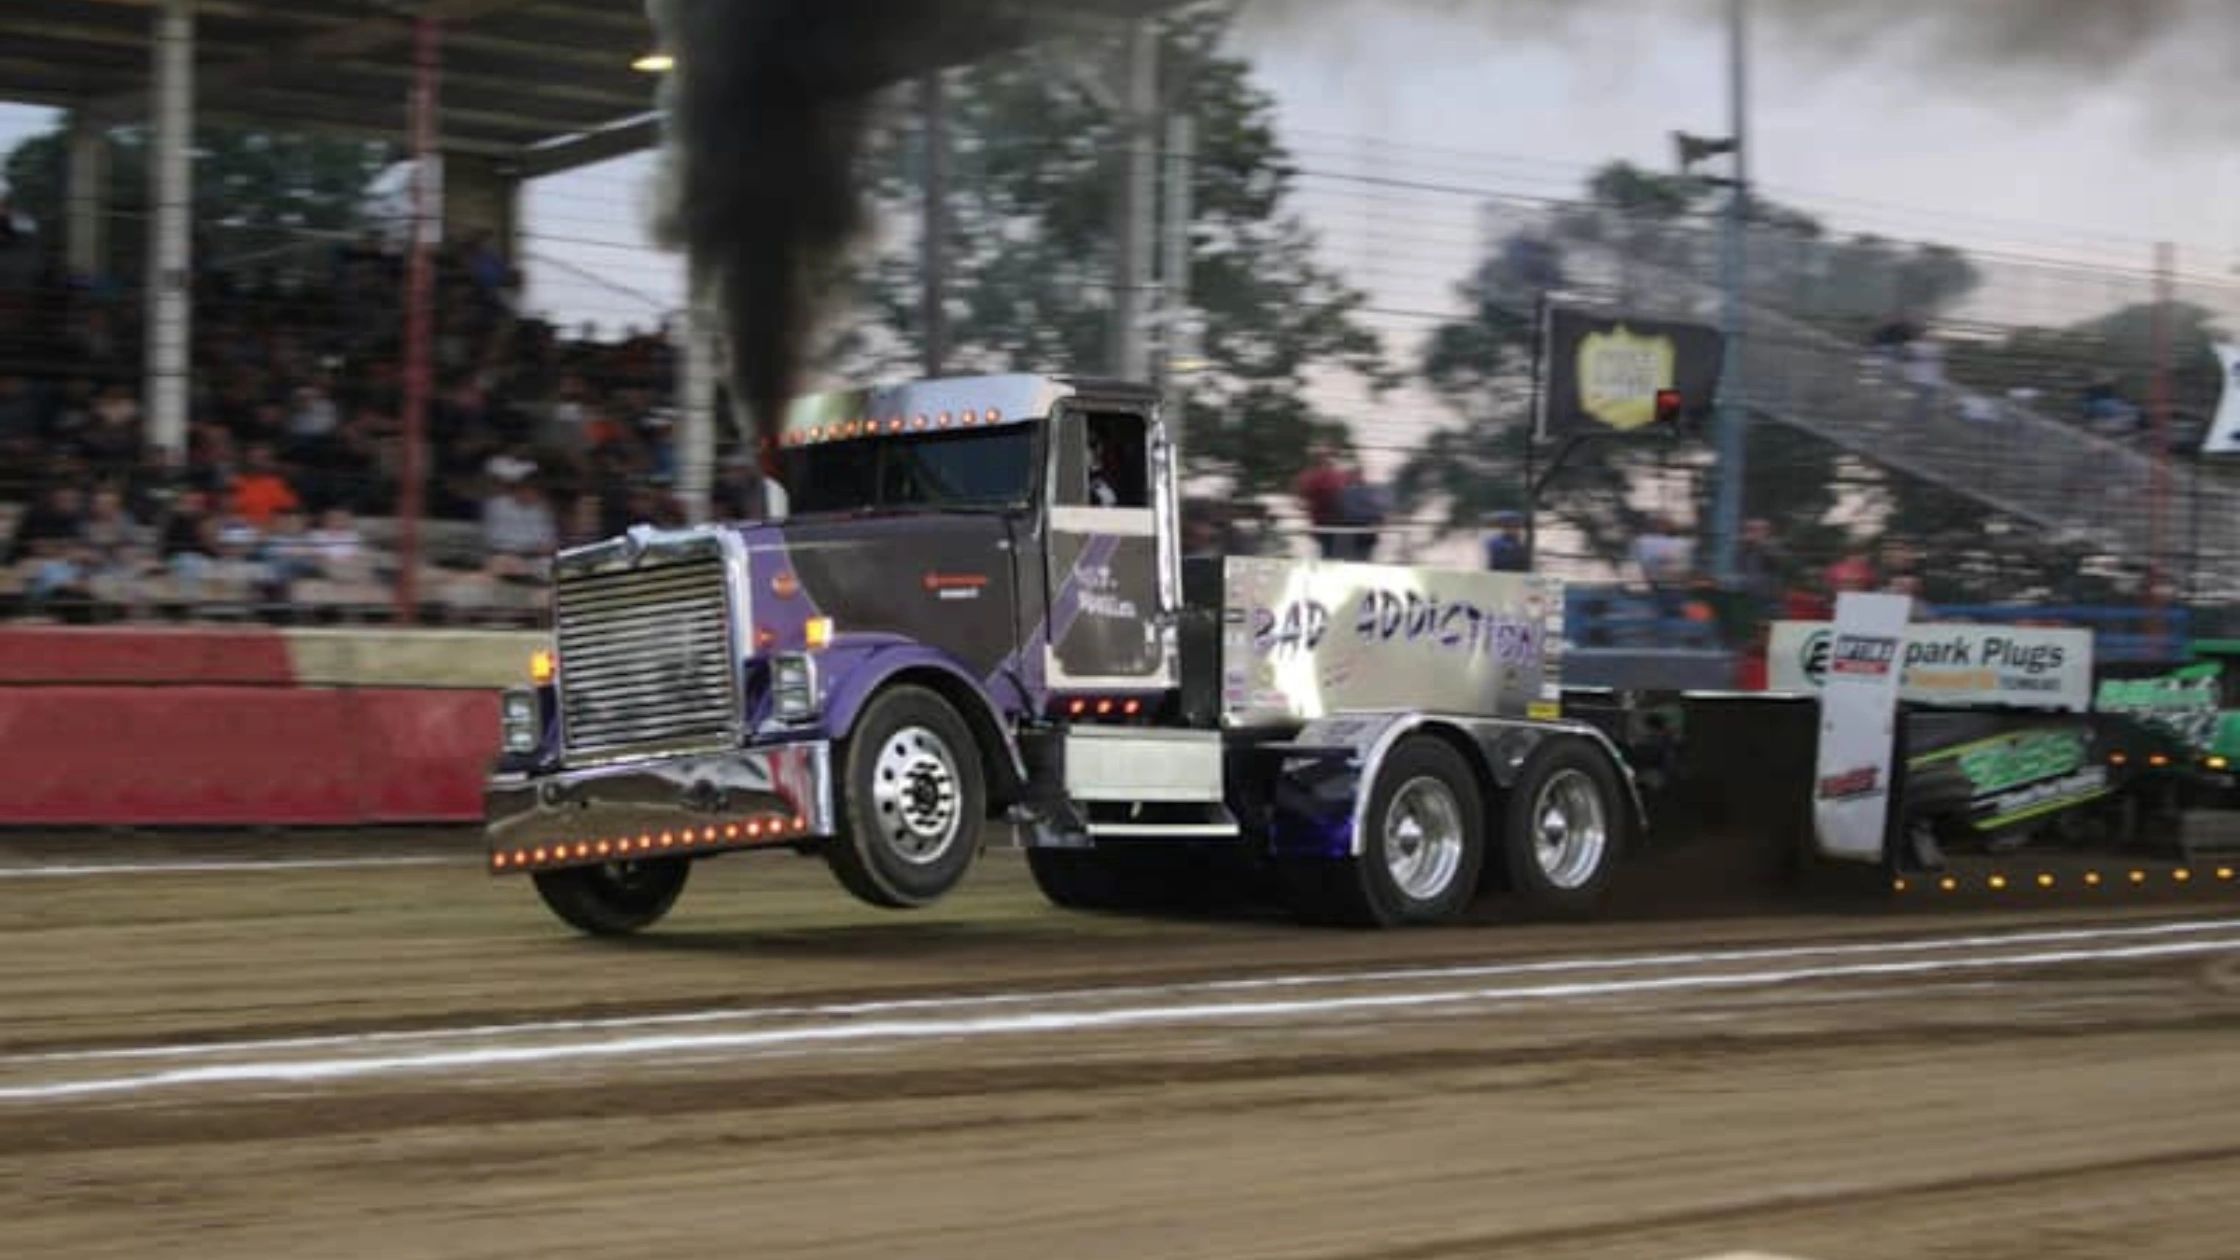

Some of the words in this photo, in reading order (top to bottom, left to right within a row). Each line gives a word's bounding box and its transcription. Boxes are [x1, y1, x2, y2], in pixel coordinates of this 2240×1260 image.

[1253, 599, 1328, 657] BAD
[1902, 636, 1971, 666] park
[1981, 637, 2065, 674] Plugs
